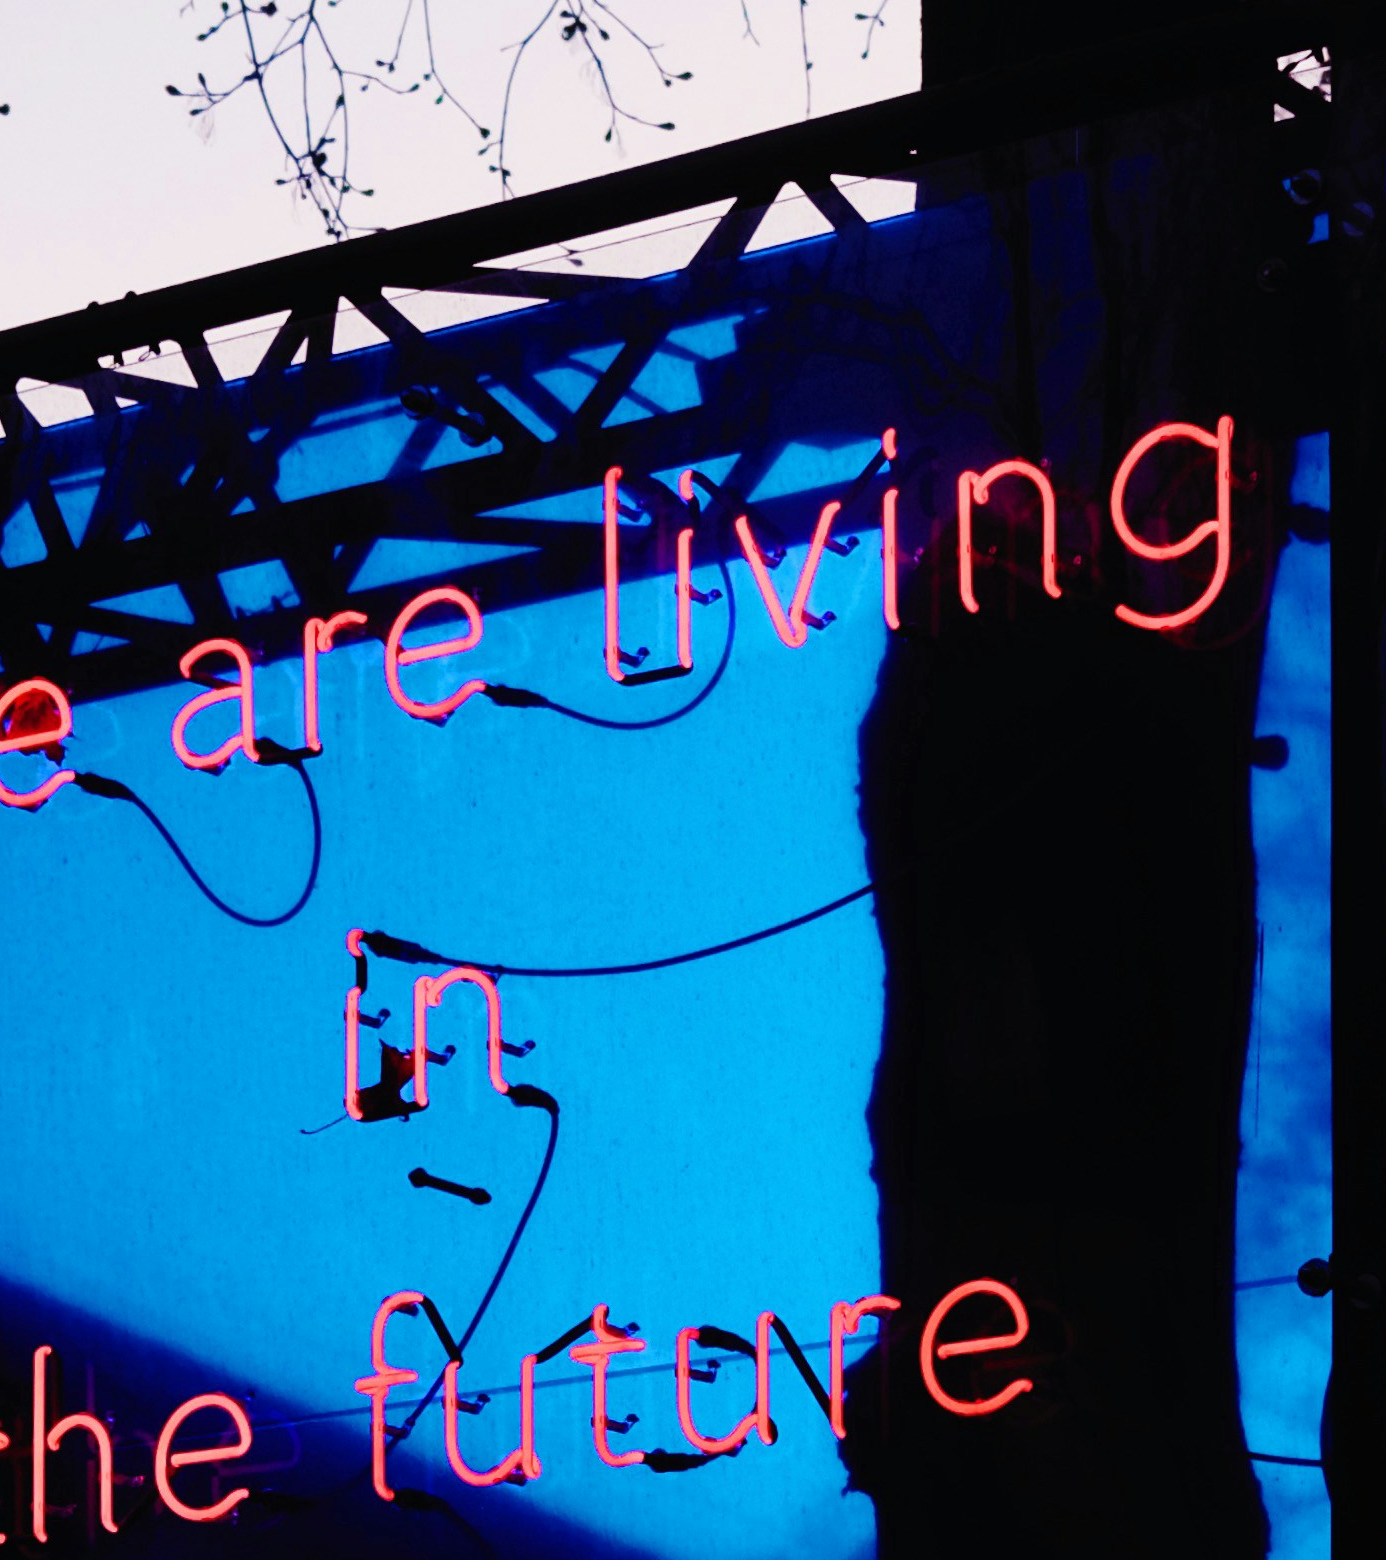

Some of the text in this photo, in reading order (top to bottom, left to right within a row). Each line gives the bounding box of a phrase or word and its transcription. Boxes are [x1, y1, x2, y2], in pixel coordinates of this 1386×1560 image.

[169, 583, 488, 773] are
[601, 414, 1236, 685] living
[342, 926, 511, 1123] in
[352, 1276, 1036, 1503] future
